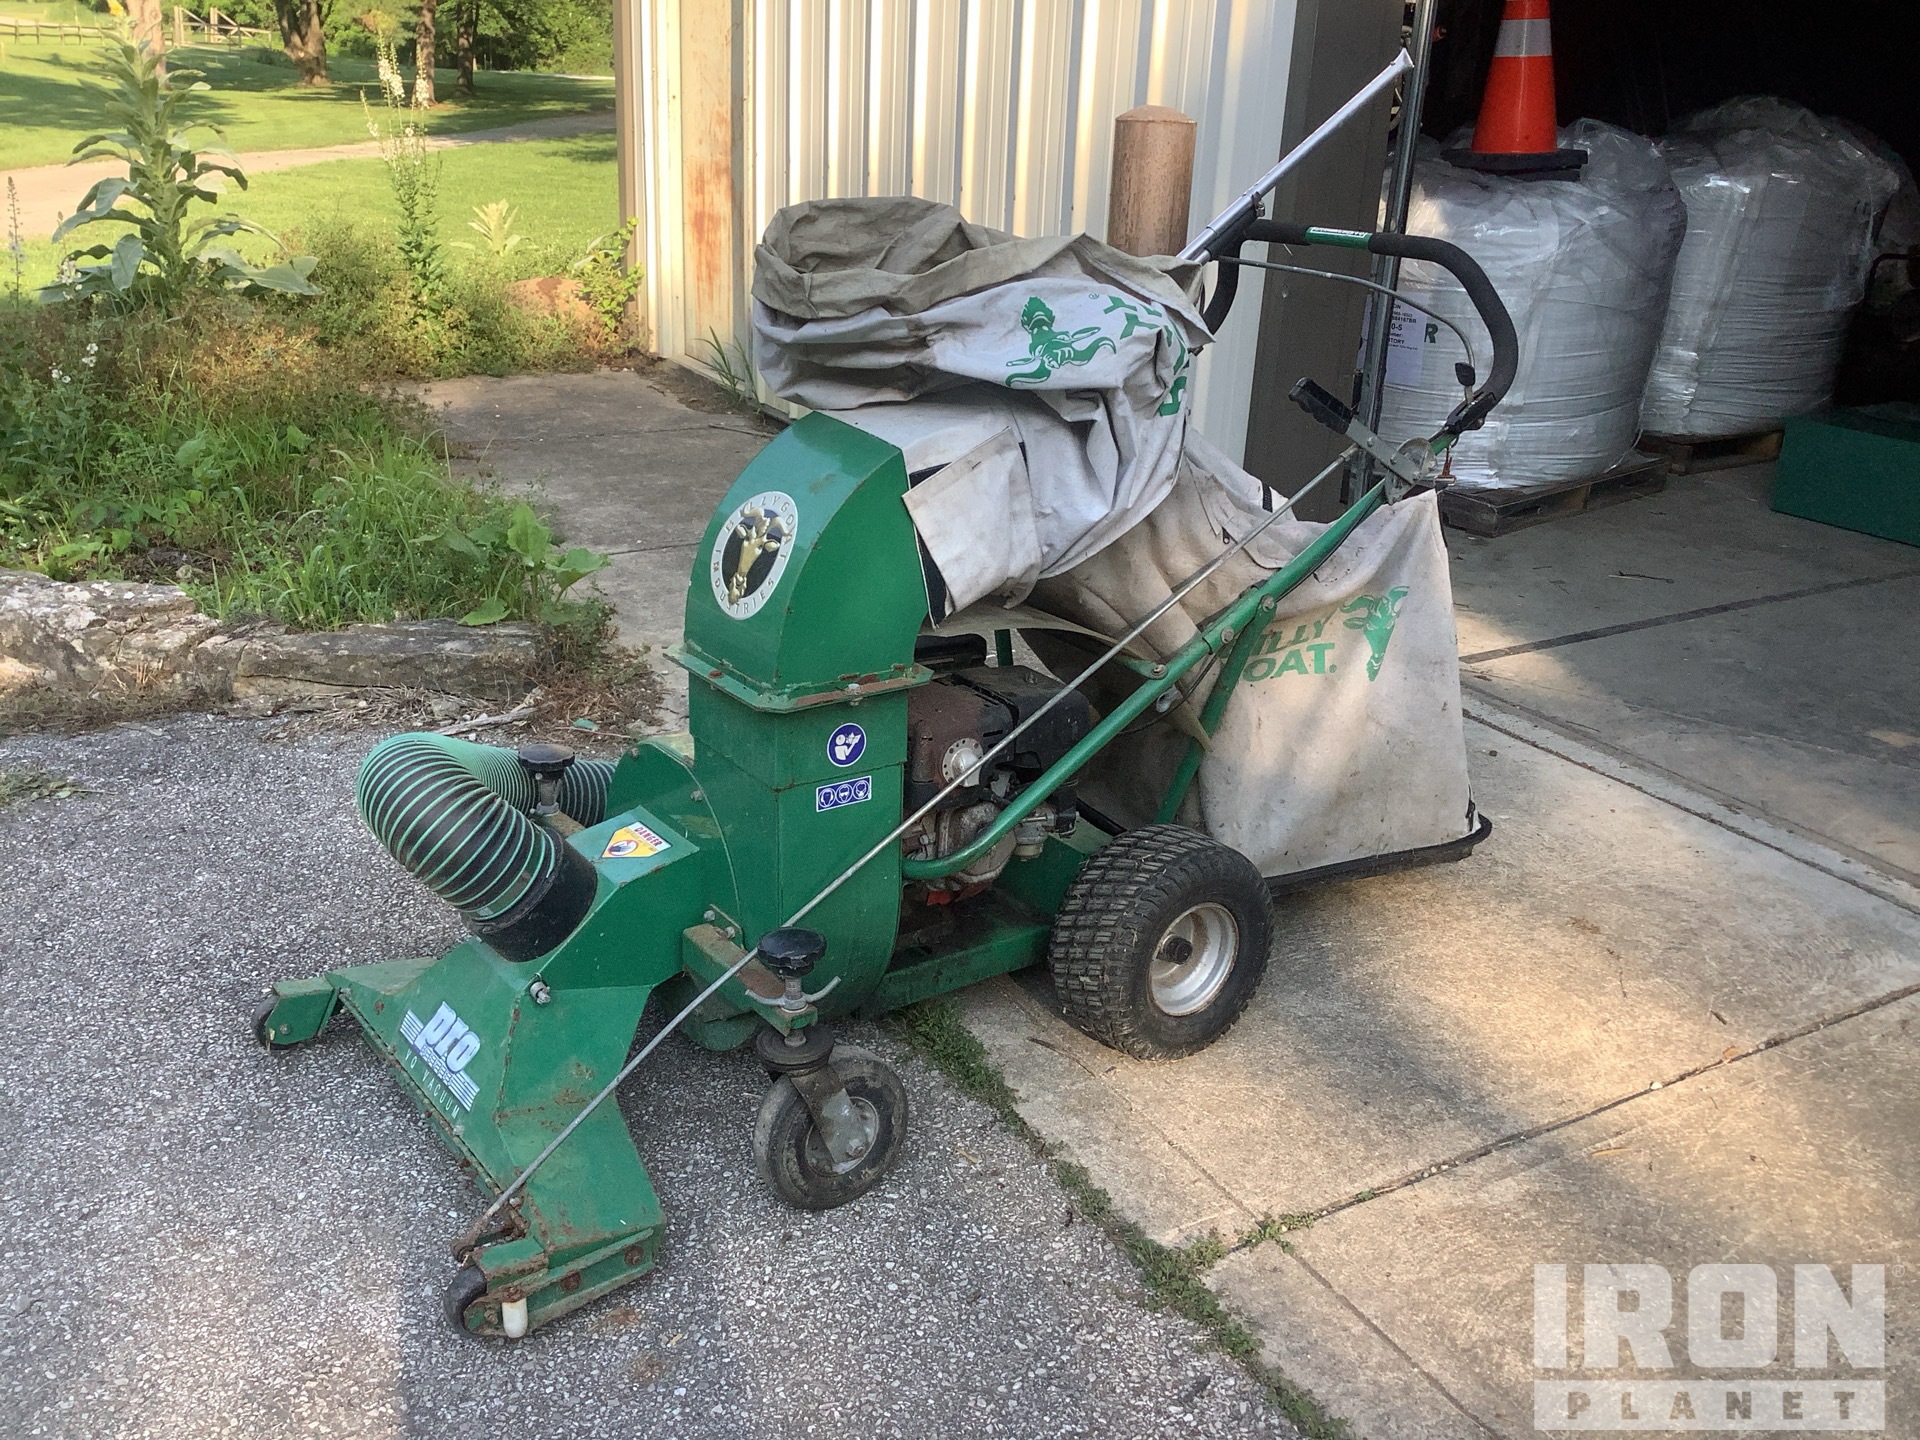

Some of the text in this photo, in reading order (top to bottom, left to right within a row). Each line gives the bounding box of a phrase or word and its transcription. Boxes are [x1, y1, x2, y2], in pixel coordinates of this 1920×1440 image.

[1391, 323, 1403, 331] 0-5
[1242, 643, 1335, 682] OAT
[634, 826, 662, 847] DANGER
[422, 1069, 460, 1119] VACUUM
